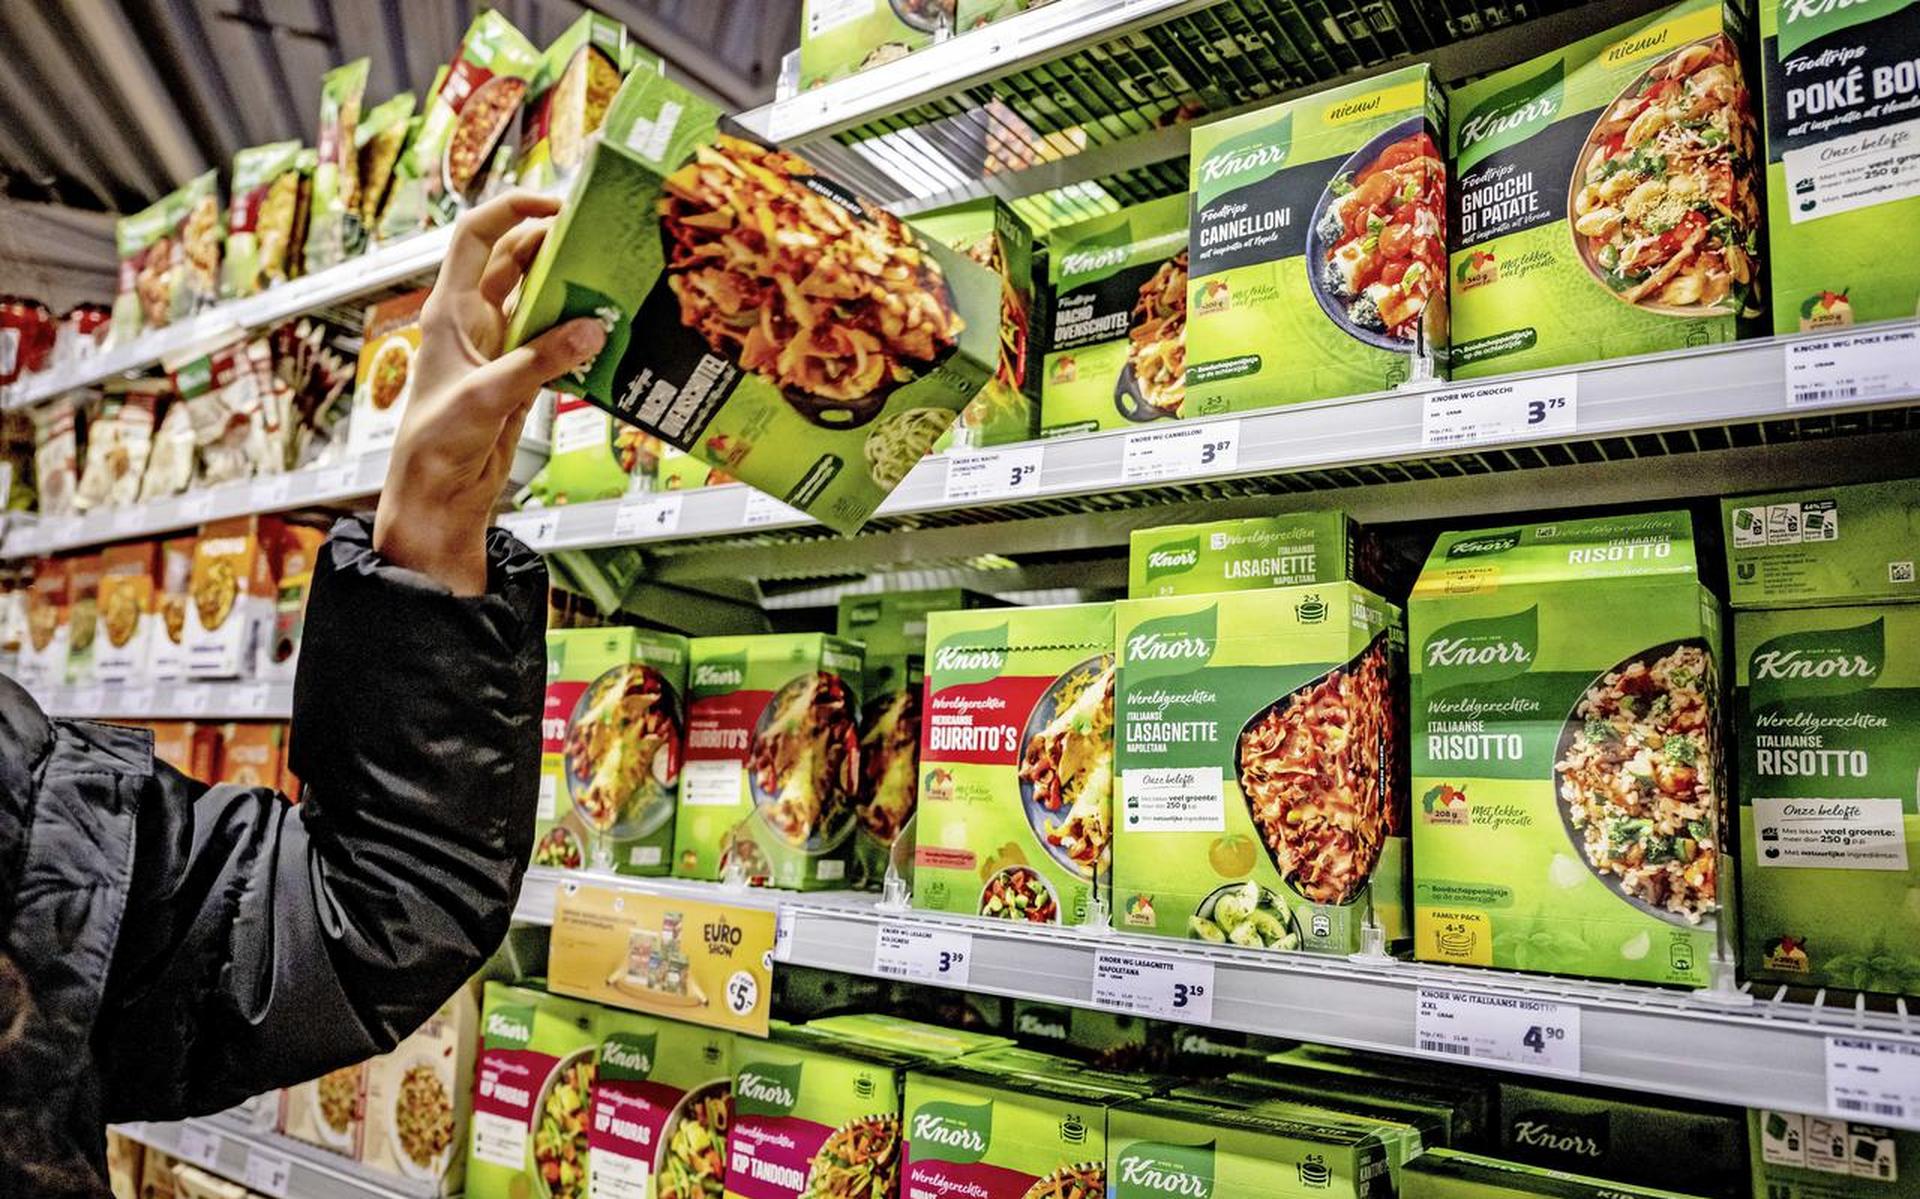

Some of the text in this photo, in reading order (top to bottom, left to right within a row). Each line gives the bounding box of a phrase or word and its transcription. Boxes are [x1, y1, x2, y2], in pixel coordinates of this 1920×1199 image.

[1607, 29, 1668, 62] nieuw!
[1785, 45, 1868, 76] Foodtrips
[1786, 66, 1866, 121] POKÉ
[1329, 95, 1382, 121] nieuw!
[1460, 97, 1559, 149] Knorr
[1820, 131, 1910, 161] Onze belofte
[1200, 146, 1285, 183] Knorr
[1863, 167, 1900, 180] 250 g
[1868, 157, 1894, 169] veel
[1462, 162, 1515, 189] Foodtrips
[1461, 172, 1533, 214] GNOCCHI
[1200, 202, 1248, 224] Foodtrips
[1461, 190, 1539, 235] DI PATATE
[1199, 206, 1291, 247] CANNELLONI
[1060, 248, 1128, 277] Knorr
[1054, 311, 1130, 342] OVENSCHOTEL
[1055, 305, 1095, 327] NACHO
[1431, 386, 1513, 403] KNORR WG GNOCCHI
[1452, 538, 1515, 554] Knorr
[1608, 535, 1670, 546] ITALIAANSE
[1148, 549, 1197, 568] Knorr
[1568, 543, 1671, 565] RISOTTO
[1224, 554, 1317, 579] LASAGNETTE
[935, 644, 1004, 672] Knorr
[1127, 633, 1210, 662] Knorr
[1426, 636, 1531, 667] Knorr
[694, 664, 742, 686] Knorr
[1754, 650, 1877, 680] Knorr
[1127, 689, 1216, 711] Wereldgerechten
[1428, 697, 1540, 719] Wereldgerechten
[1127, 710, 1163, 721] ITALIAANSE
[1428, 720, 1485, 733] ITALIAANSE
[1756, 711, 1889, 735] Wereldgerechten
[930, 724, 1017, 751] BURRITO'S
[1126, 721, 1218, 742] LASAGNETTE
[1756, 735, 1824, 748] ITALIAANSE
[1127, 742, 1168, 753] NAPOLETANA
[1428, 734, 1523, 760] RISOTTO
[1756, 750, 1868, 777] RISOTTO
[1142, 773, 1195, 788] Onze belofte
[1166, 801, 1180, 809] 250
[1494, 804, 1527, 816] lekker
[1783, 803, 1862, 821] Onze belofte
[1820, 835, 1841, 843] 250
[1842, 836, 1850, 845] g
[1823, 827, 1846, 835] veel
[1847, 828, 1896, 838] groente:
[1800, 850, 1846, 859] natuurlijke
[1431, 911, 1481, 922] FAMILY PACK
[704, 923, 743, 946] EURO
[1445, 924, 1466, 933] 4-5
[1098, 965, 1139, 976] NAPOLETANA
[1135, 959, 1174, 971] LASAGNETTE
[1421, 990, 1451, 1001] KNORR
[1451, 993, 1468, 1003] WG
[1468, 994, 1518, 1009] ITALIAANSE
[1421, 1001, 1438, 1010] XXL
[488, 1013, 530, 1043] Knorr
[1017, 1015, 1069, 1040] Knorr
[602, 1041, 651, 1073] Knorr
[738, 1072, 795, 1108] Knorr
[912, 1110, 986, 1153] Knorr
[1515, 1120, 1602, 1158] Knorr
[1305, 1153, 1324, 1164] 4-5
[750, 1156, 805, 1193] TANDOORI
[910, 1168, 989, 1197] Wereldgerechten
[1119, 1155, 1210, 1199] Knorr
